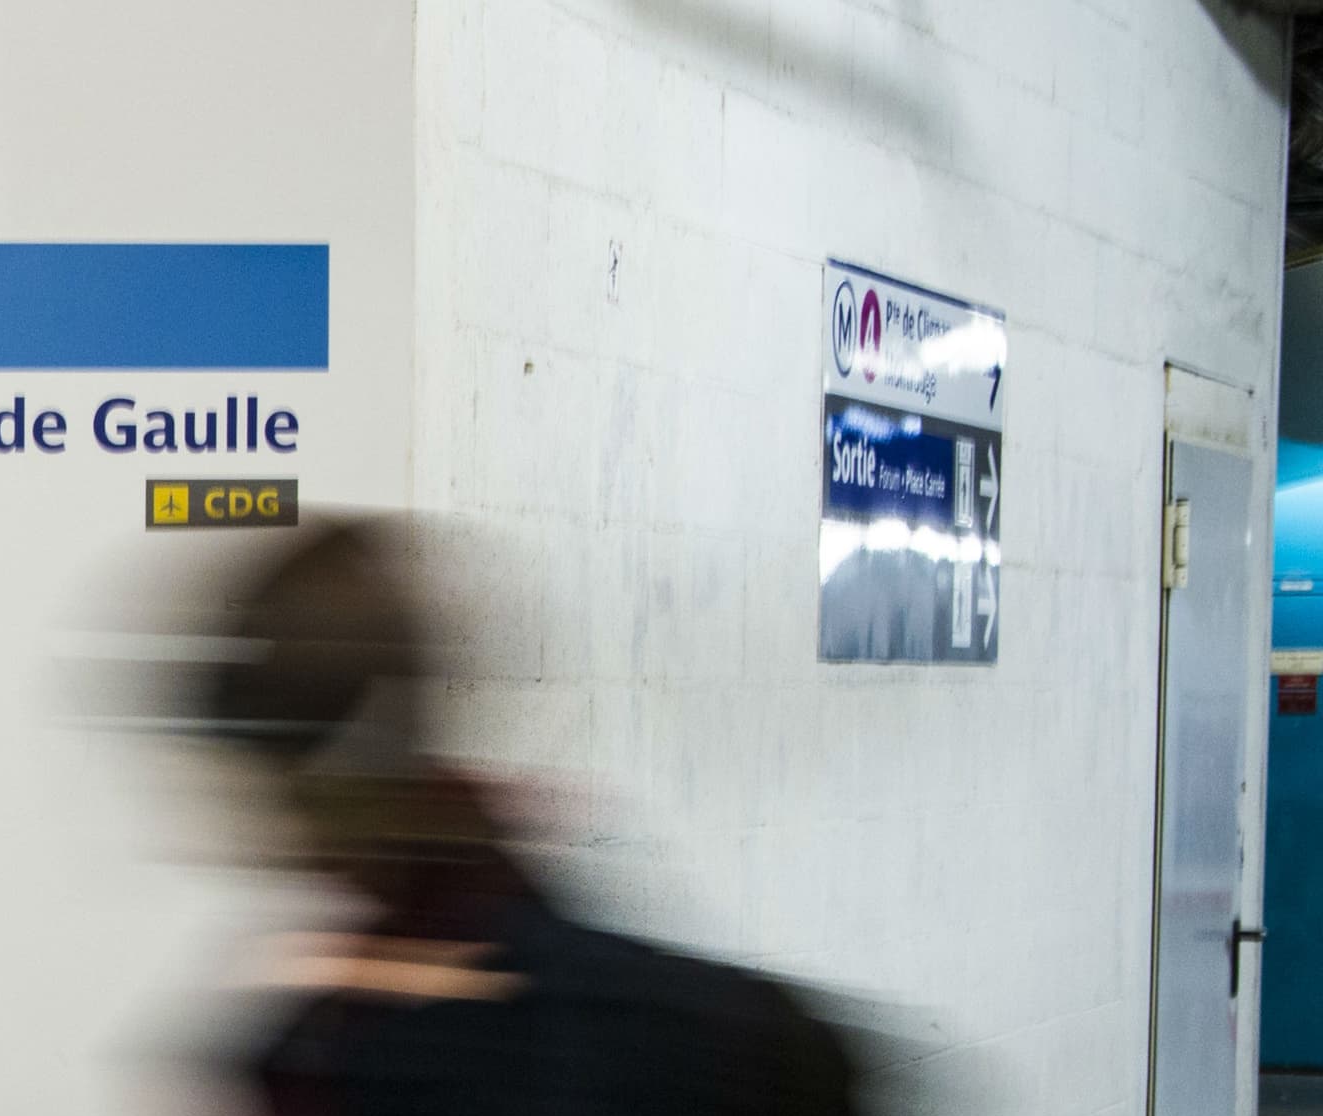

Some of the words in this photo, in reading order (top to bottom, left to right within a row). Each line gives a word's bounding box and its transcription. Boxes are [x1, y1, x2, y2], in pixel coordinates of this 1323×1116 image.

[903, 304, 915, 341] de
[92, 396, 299, 454] Gaulle
[832, 430, 876, 488] Sortie
[905, 466, 923, 496] Place
[204, 486, 280, 519] CDG
